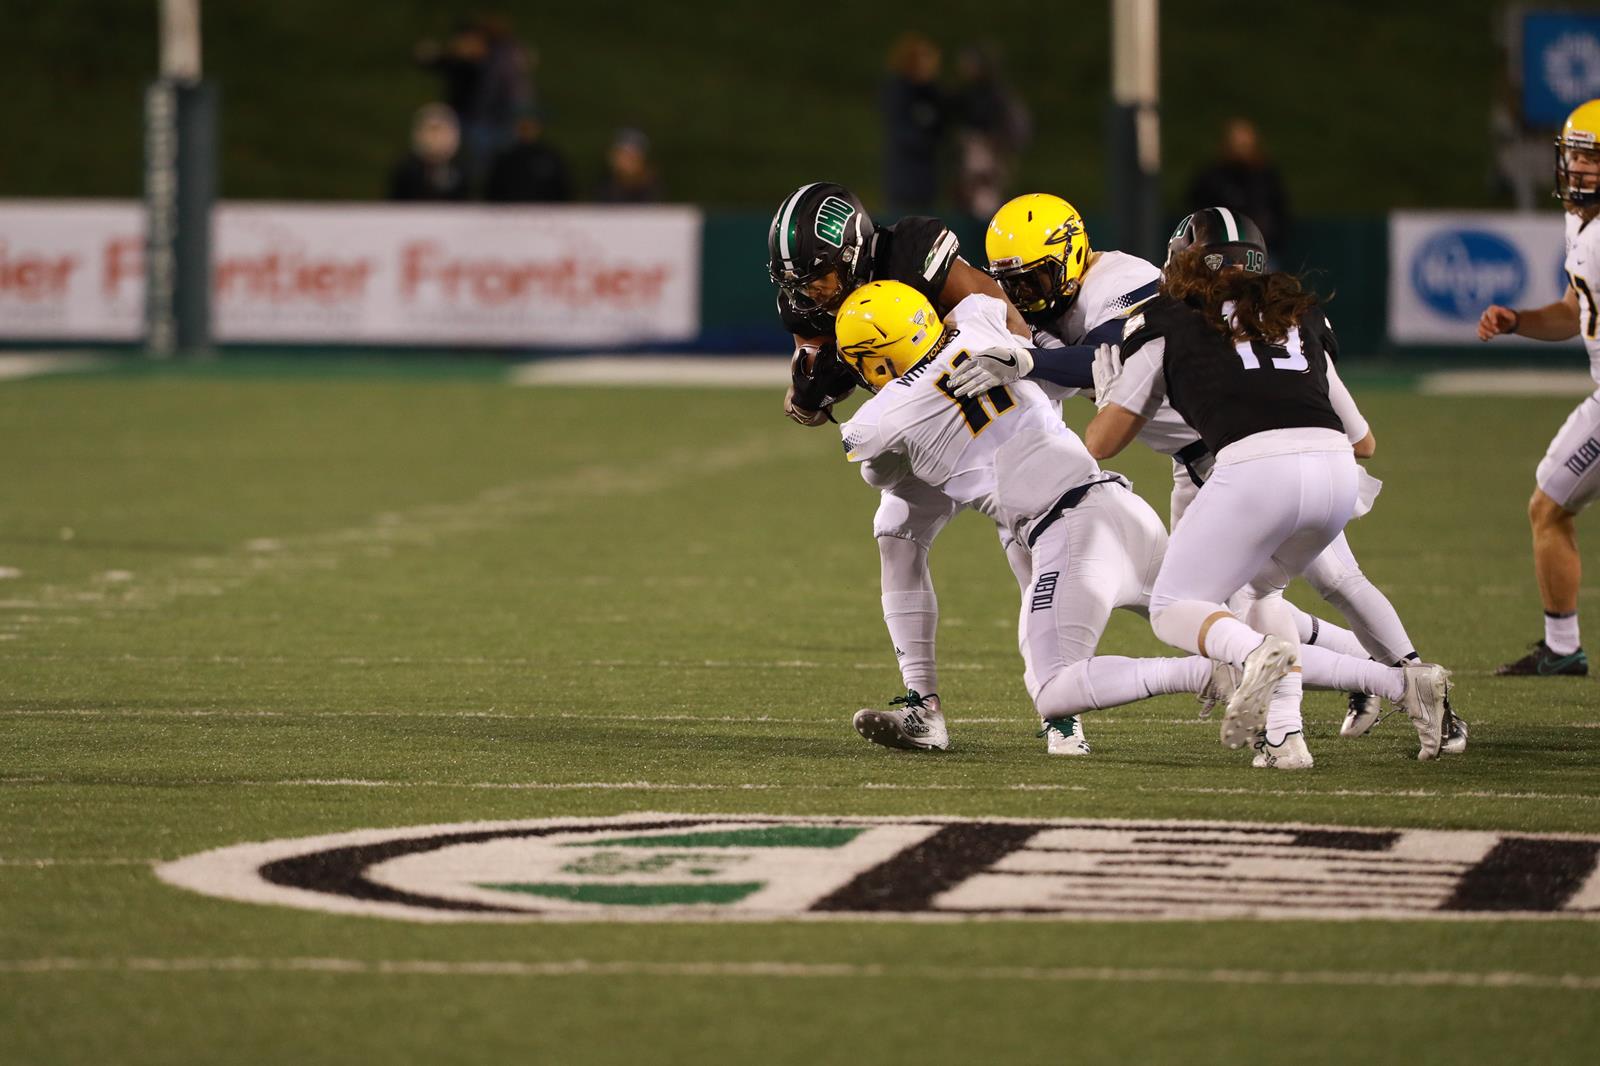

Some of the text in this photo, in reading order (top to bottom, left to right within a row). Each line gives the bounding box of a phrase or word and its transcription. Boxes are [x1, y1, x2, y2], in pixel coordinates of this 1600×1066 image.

[815, 196, 856, 249] OHIO
[398, 235, 672, 309] Frontier
[1245, 249, 1264, 274] 19
[1031, 571, 1060, 613] TOLEDO
